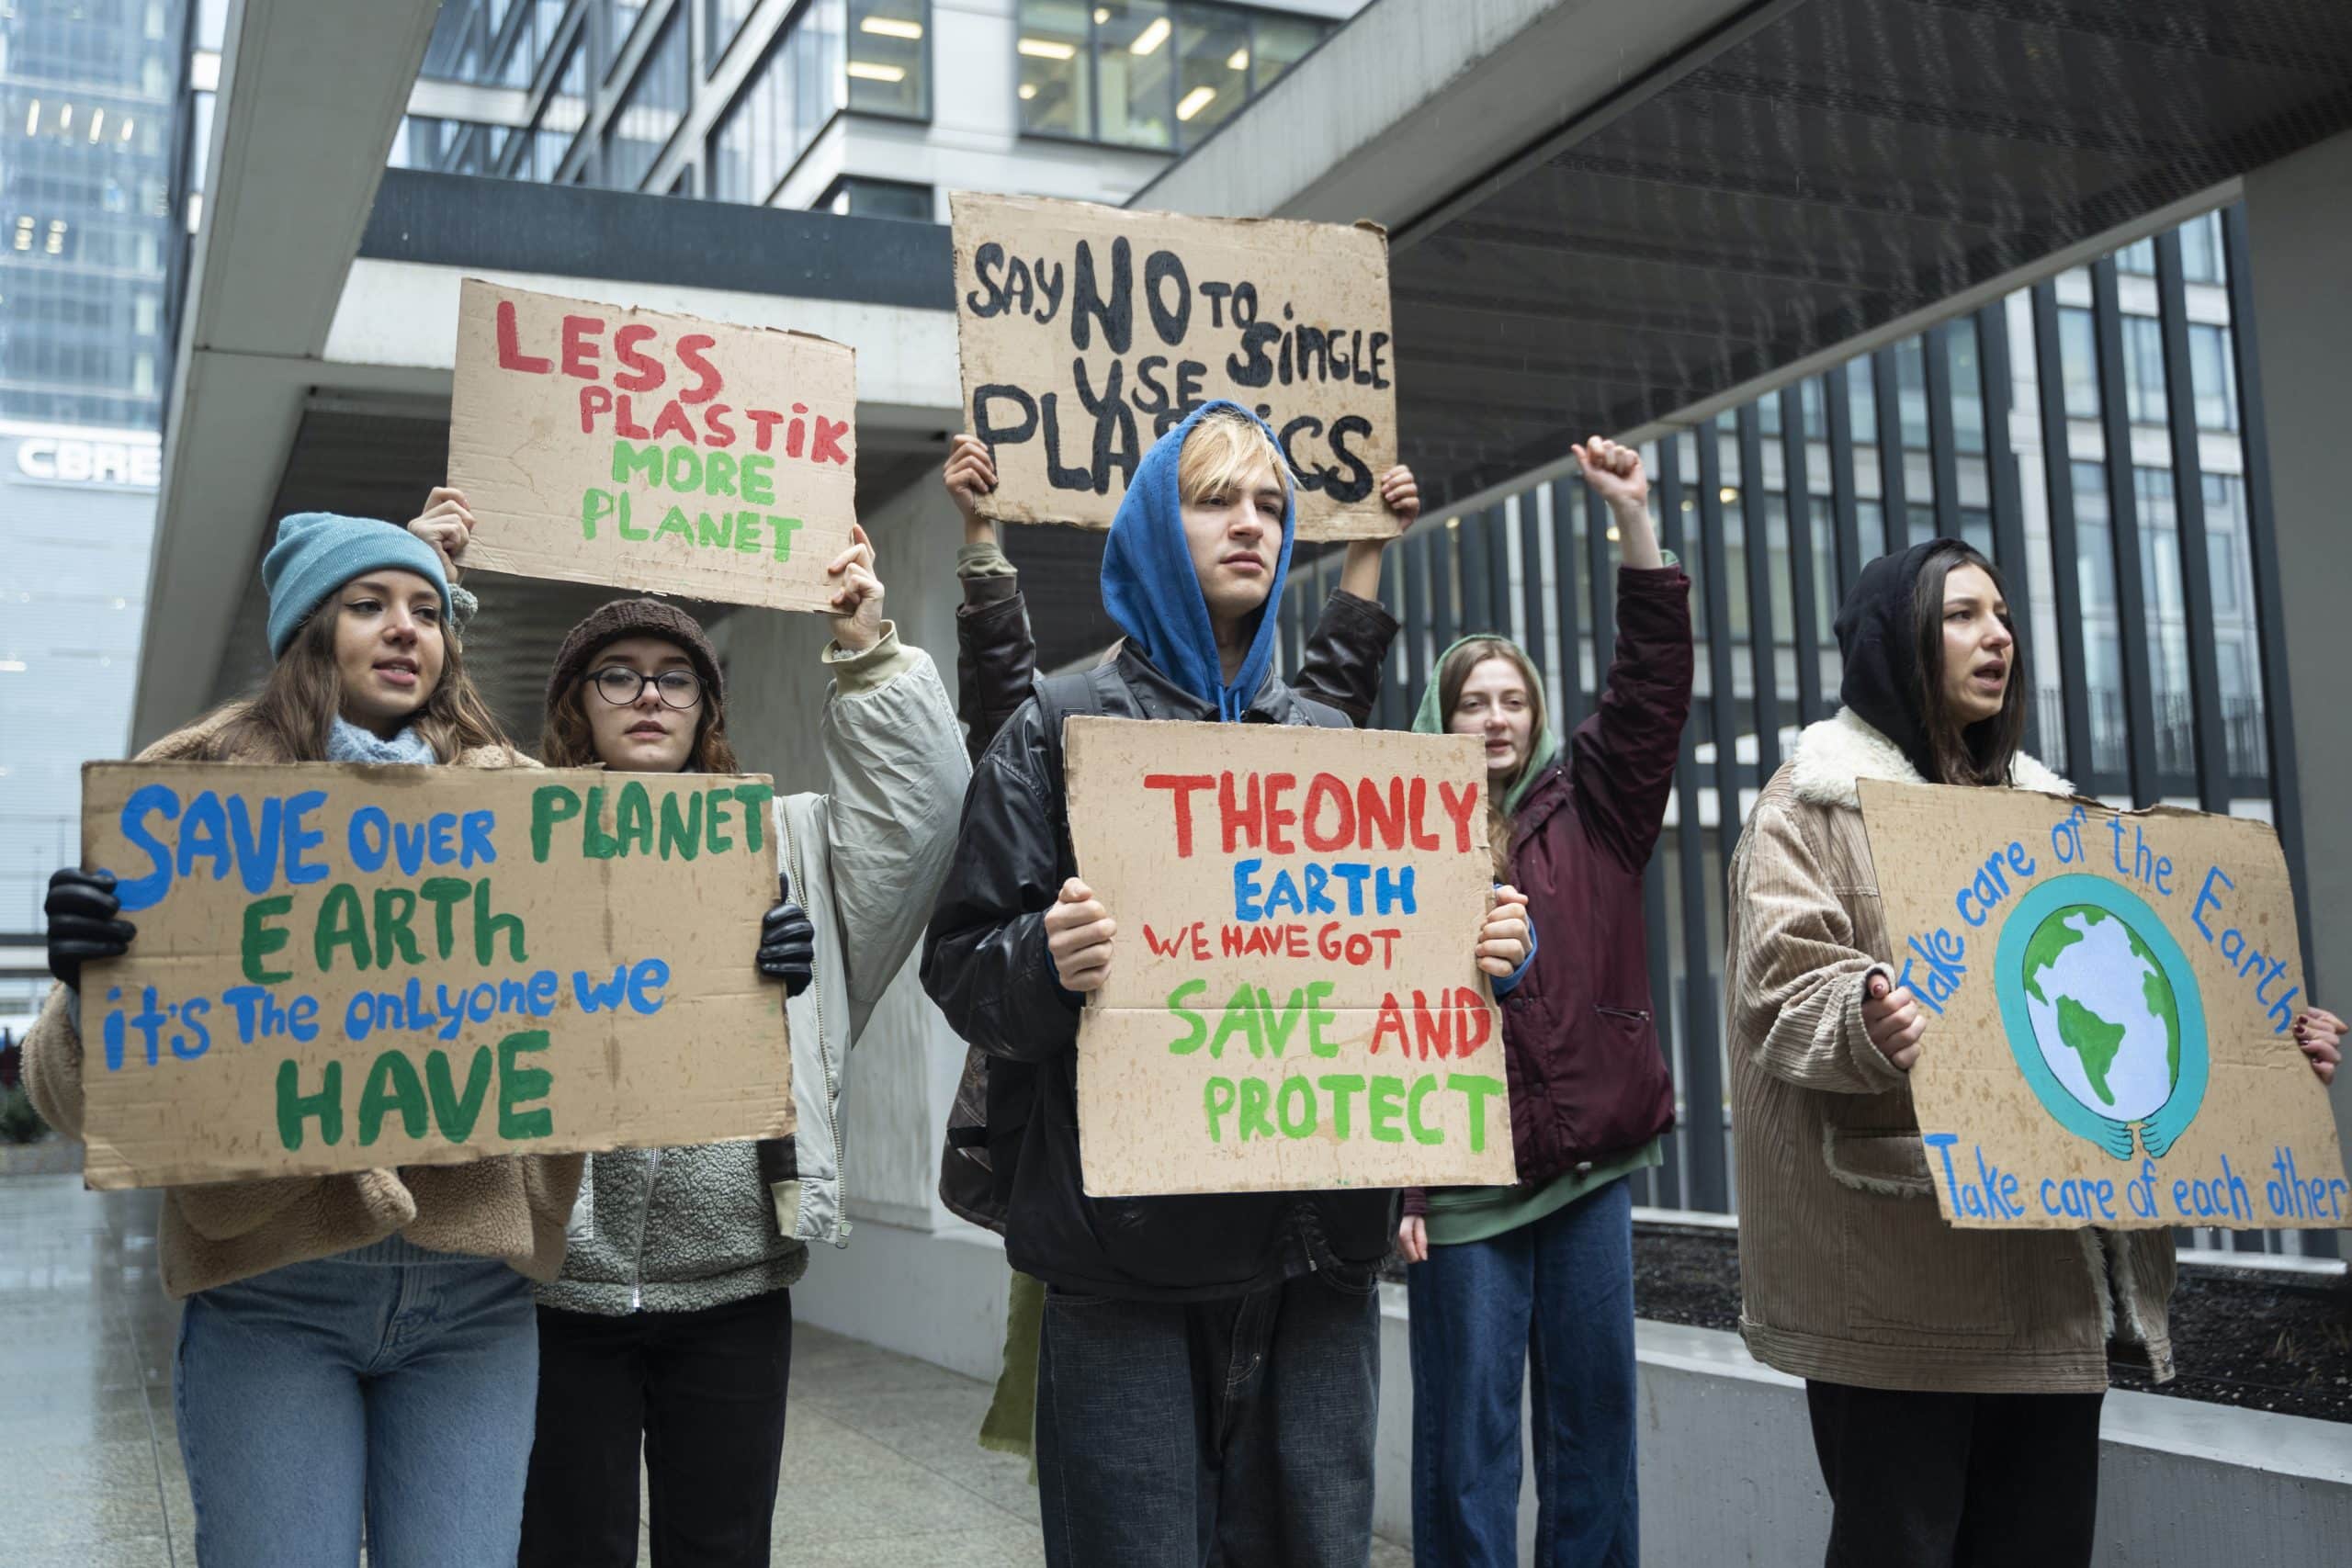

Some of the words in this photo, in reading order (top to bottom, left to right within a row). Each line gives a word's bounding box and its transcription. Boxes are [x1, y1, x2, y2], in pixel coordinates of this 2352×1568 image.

[1071, 235, 1192, 355] NO
[1199, 281, 1258, 329] TO
[496, 300, 724, 405] LESS
[1073, 355, 1207, 419] USE
[17, 437, 161, 485] CBRE
[613, 440, 776, 506] MORE
[582, 488, 803, 563] PLANET
[96, 784, 330, 911] SAVE
[530, 781, 774, 862] PLANET
[1233, 858, 1418, 921] EARTH
[1899, 928, 1967, 1015] Take
[1956, 840, 2036, 927] care
[2052, 805, 2087, 863] of
[2106, 815, 2173, 897] the
[2191, 866, 2299, 1034] Earth
[572, 958, 670, 1014] we
[1143, 921, 1214, 961] WE
[1221, 924, 1310, 958] HAVE
[1317, 921, 1402, 970] GOT
[1167, 978, 1340, 1059] SAVE
[1369, 986, 1492, 1061] AND
[276, 1029, 553, 1152] HAVE
[1204, 1073, 1506, 1154] PROTECT
[1925, 1134, 2026, 1221] Take
[2040, 1177, 2117, 1220] care
[2127, 1157, 2159, 1219] of
[2173, 1153, 2254, 1221] each
[2266, 1145, 2348, 1221] other
